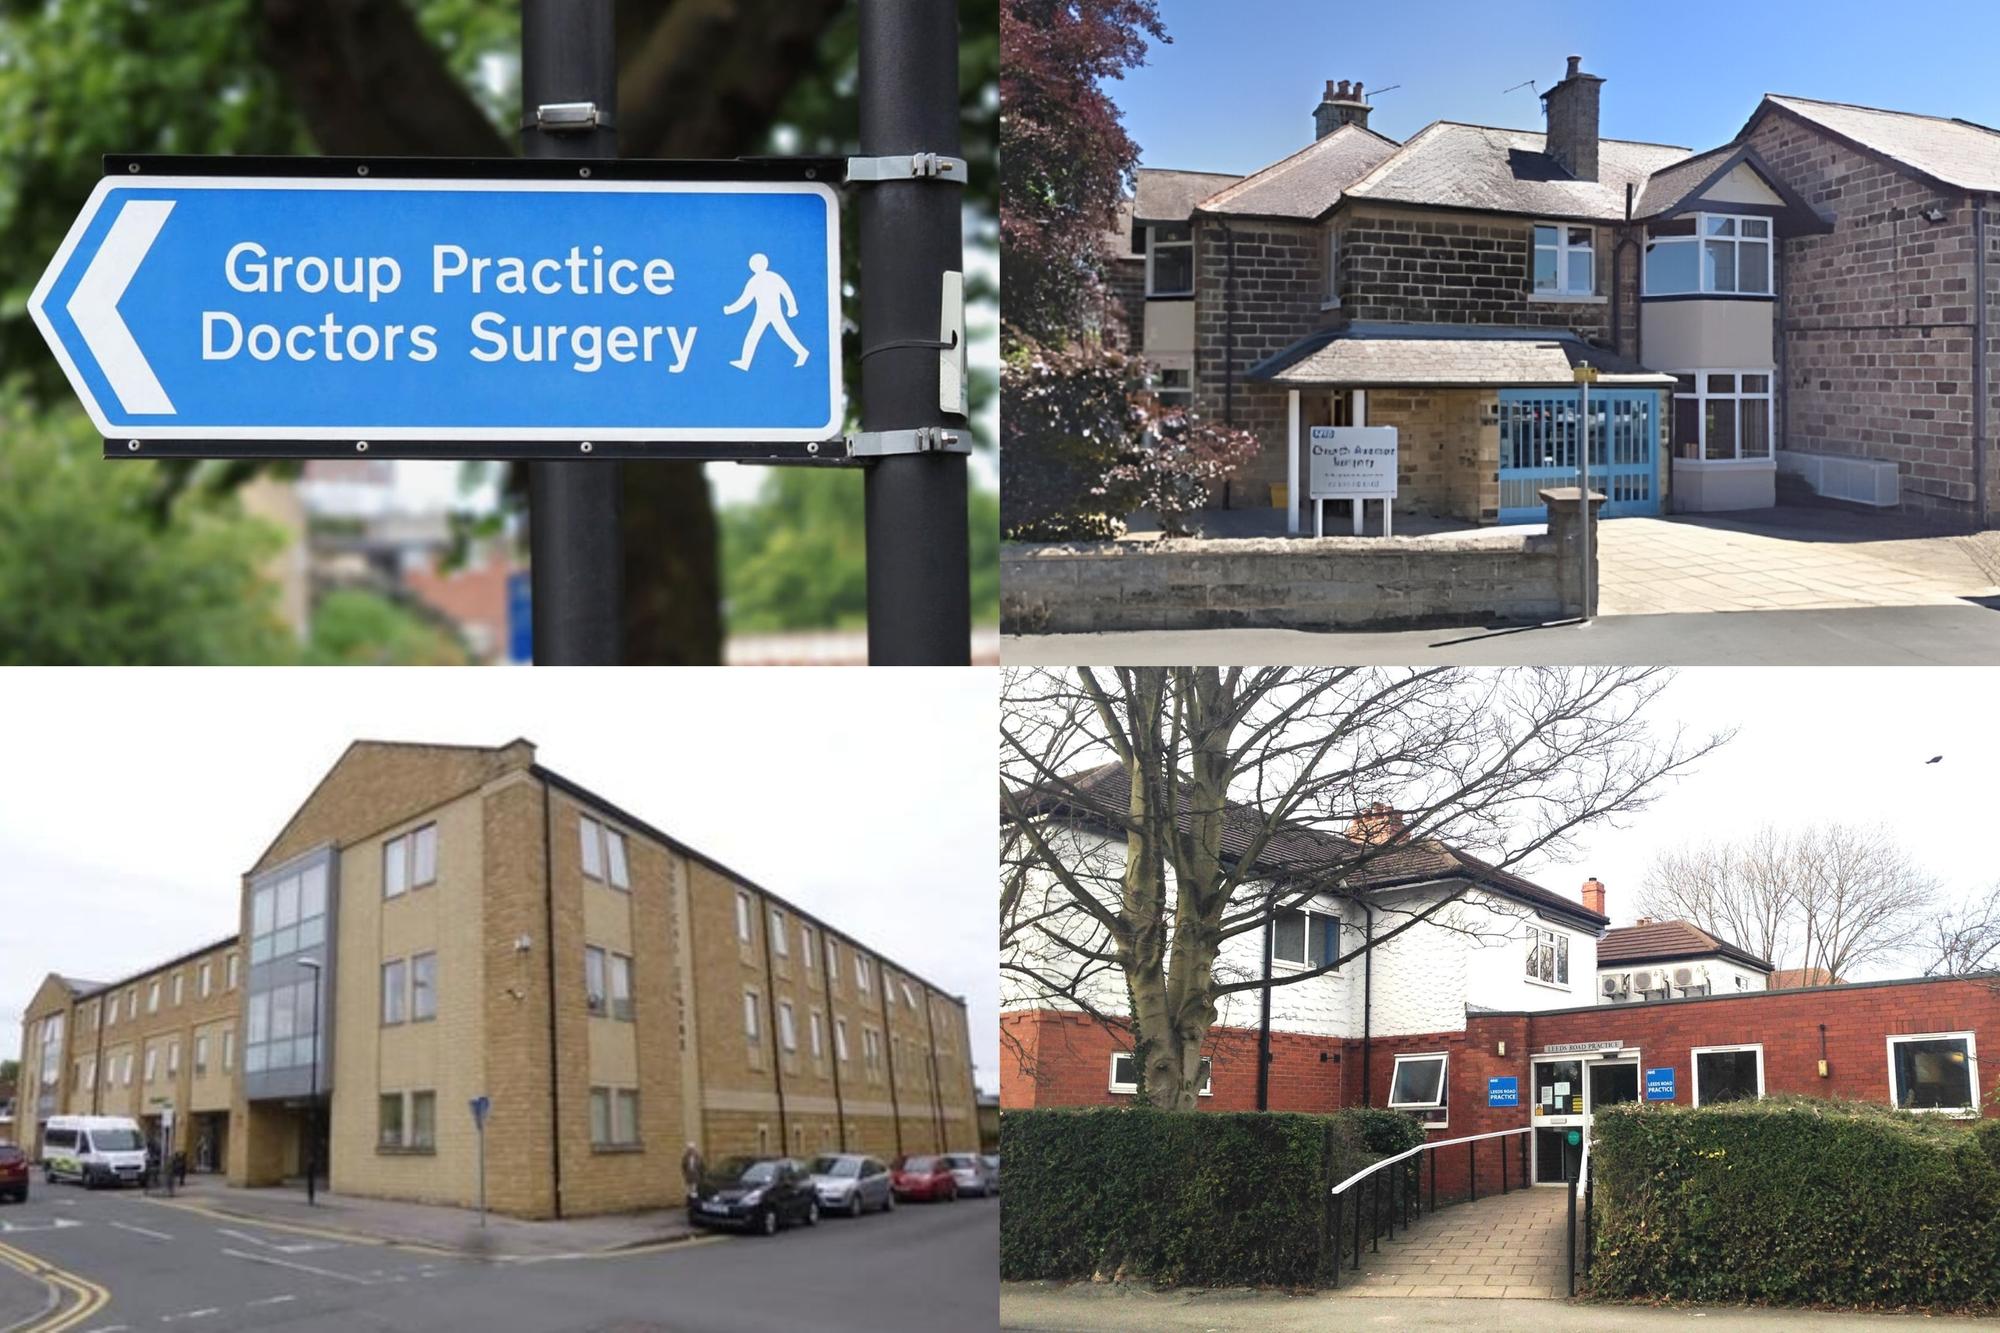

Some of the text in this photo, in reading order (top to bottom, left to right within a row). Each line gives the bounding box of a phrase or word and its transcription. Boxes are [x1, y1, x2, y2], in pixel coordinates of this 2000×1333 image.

[224, 241, 675, 302] Group Practice
[202, 311, 698, 373] Doctors Surgery
[1588, 1042, 1619, 1050] PRACTICE
